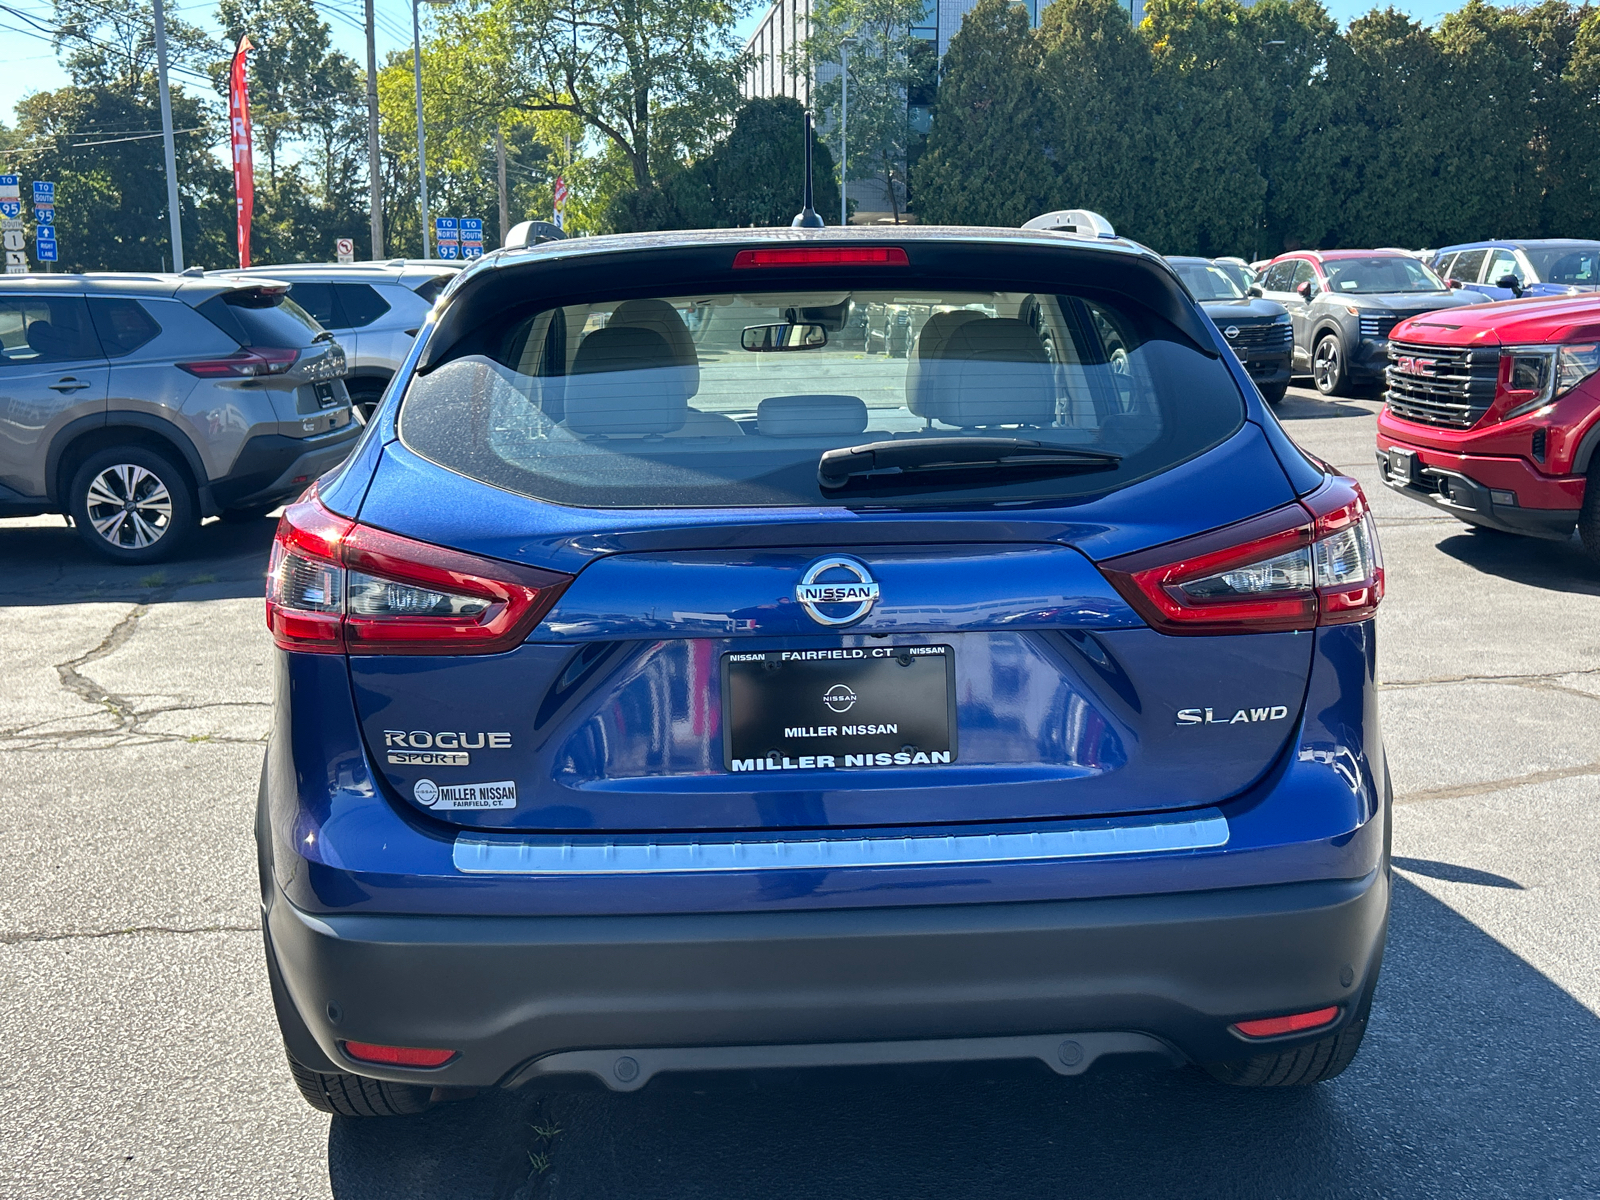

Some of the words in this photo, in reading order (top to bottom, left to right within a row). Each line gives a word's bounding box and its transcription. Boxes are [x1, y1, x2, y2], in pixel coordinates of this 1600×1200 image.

[2, 204, 19, 215] 95
[38, 211, 53, 222] 95
[12, 235, 17, 246] 1
[441, 247, 456, 258] 95
[1398, 356, 1437, 377] GMC
[805, 587, 870, 599] NISSAN
[781, 650, 867, 660] FAIRFIELD,
[872, 648, 893, 657] CT
[909, 646, 944, 654] NISSAN
[730, 653, 765, 661] NISSAN
[1176, 707, 1230, 726] SL
[1229, 705, 1288, 725] AWD
[784, 726, 837, 738] MILLER
[842, 724, 897, 735] NISSAN
[383, 729, 512, 748] ROGUE
[395, 752, 460, 764] SPORT
[731, 756, 835, 772] MILLER
[845, 751, 950, 766] NISSAN
[441, 787, 477, 801] MILLER
[479, 786, 515, 800] NISSAN
